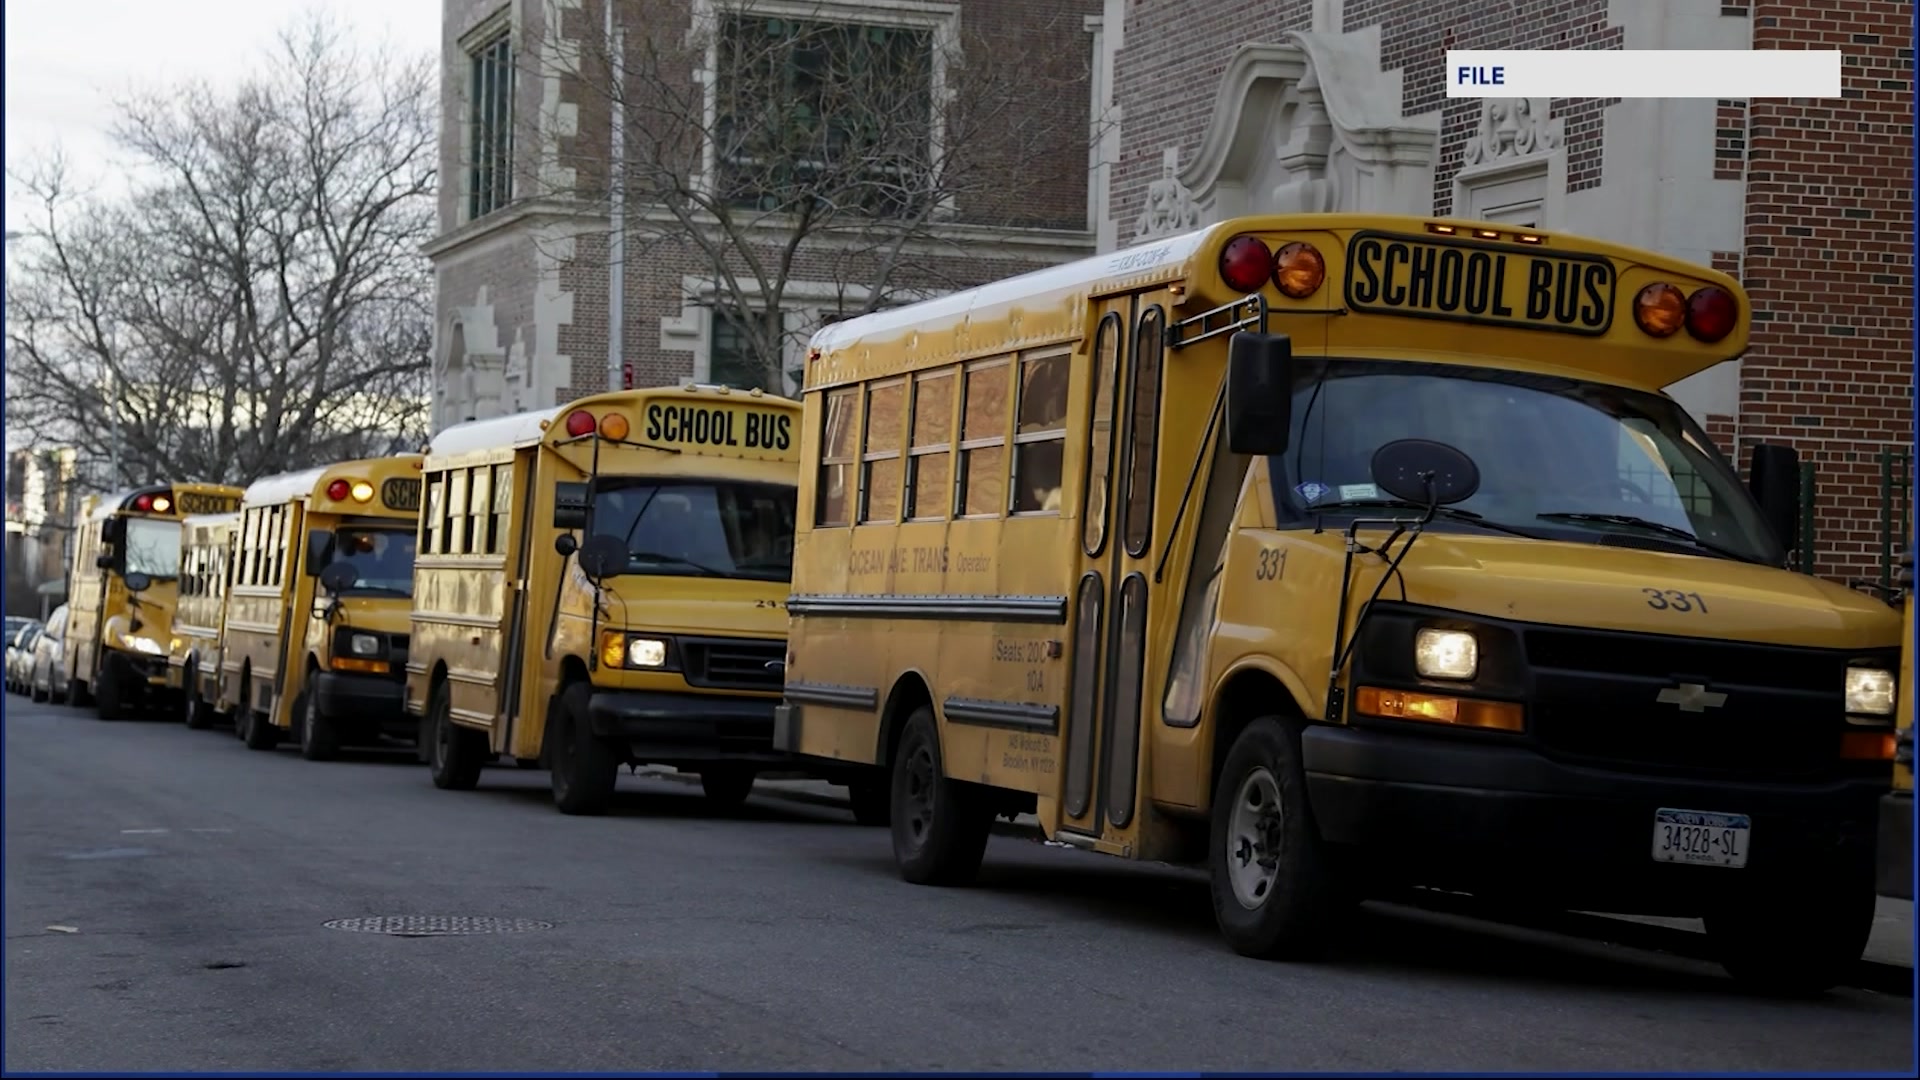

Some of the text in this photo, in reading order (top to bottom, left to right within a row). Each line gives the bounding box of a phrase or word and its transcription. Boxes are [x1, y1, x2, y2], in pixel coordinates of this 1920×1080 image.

[1355, 240, 1608, 327] SCHOOL BUS
[647, 404, 791, 450] SCHOOL BUS
[180, 492, 228, 515] SCHOOL
[388, 481, 419, 508] SCH
[848, 549, 885, 575] OCEAN
[956, 551, 992, 576] Operator
[1256, 547, 1289, 581] 331
[1642, 587, 1709, 615] 331
[996, 639, 1048, 664] Seats: 20C
[1027, 670, 1045, 692] 10A
[1663, 825, 1739, 856] 34328 SL
